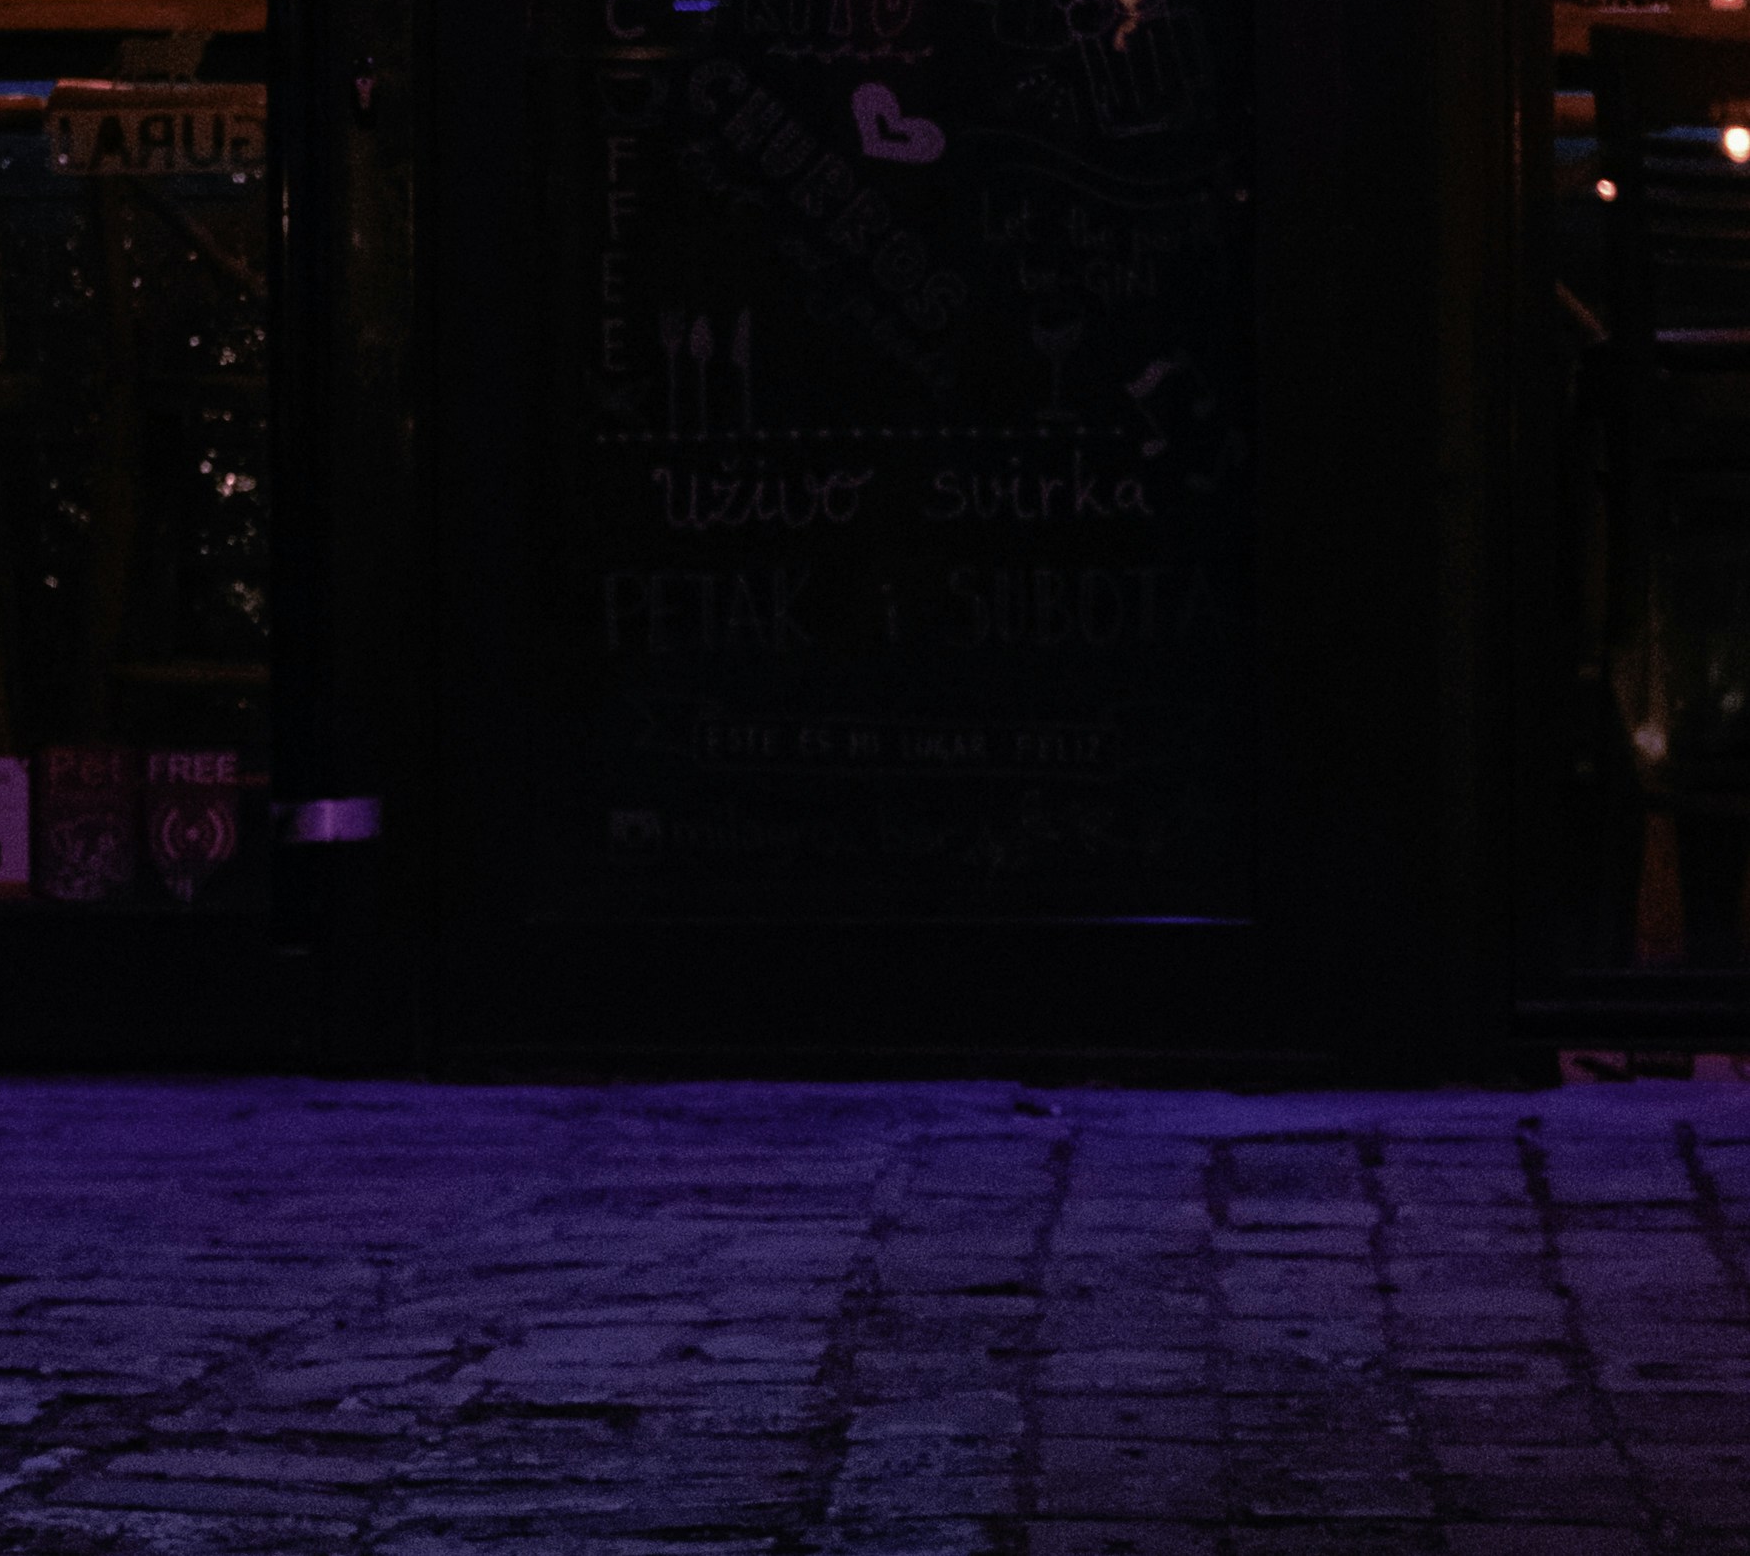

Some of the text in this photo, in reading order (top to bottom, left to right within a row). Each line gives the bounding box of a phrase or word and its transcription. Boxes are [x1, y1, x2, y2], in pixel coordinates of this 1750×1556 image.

[601, 565, 815, 653] PETAK
[947, 564, 1228, 650] SUBOTA
[148, 751, 239, 787] FREE
